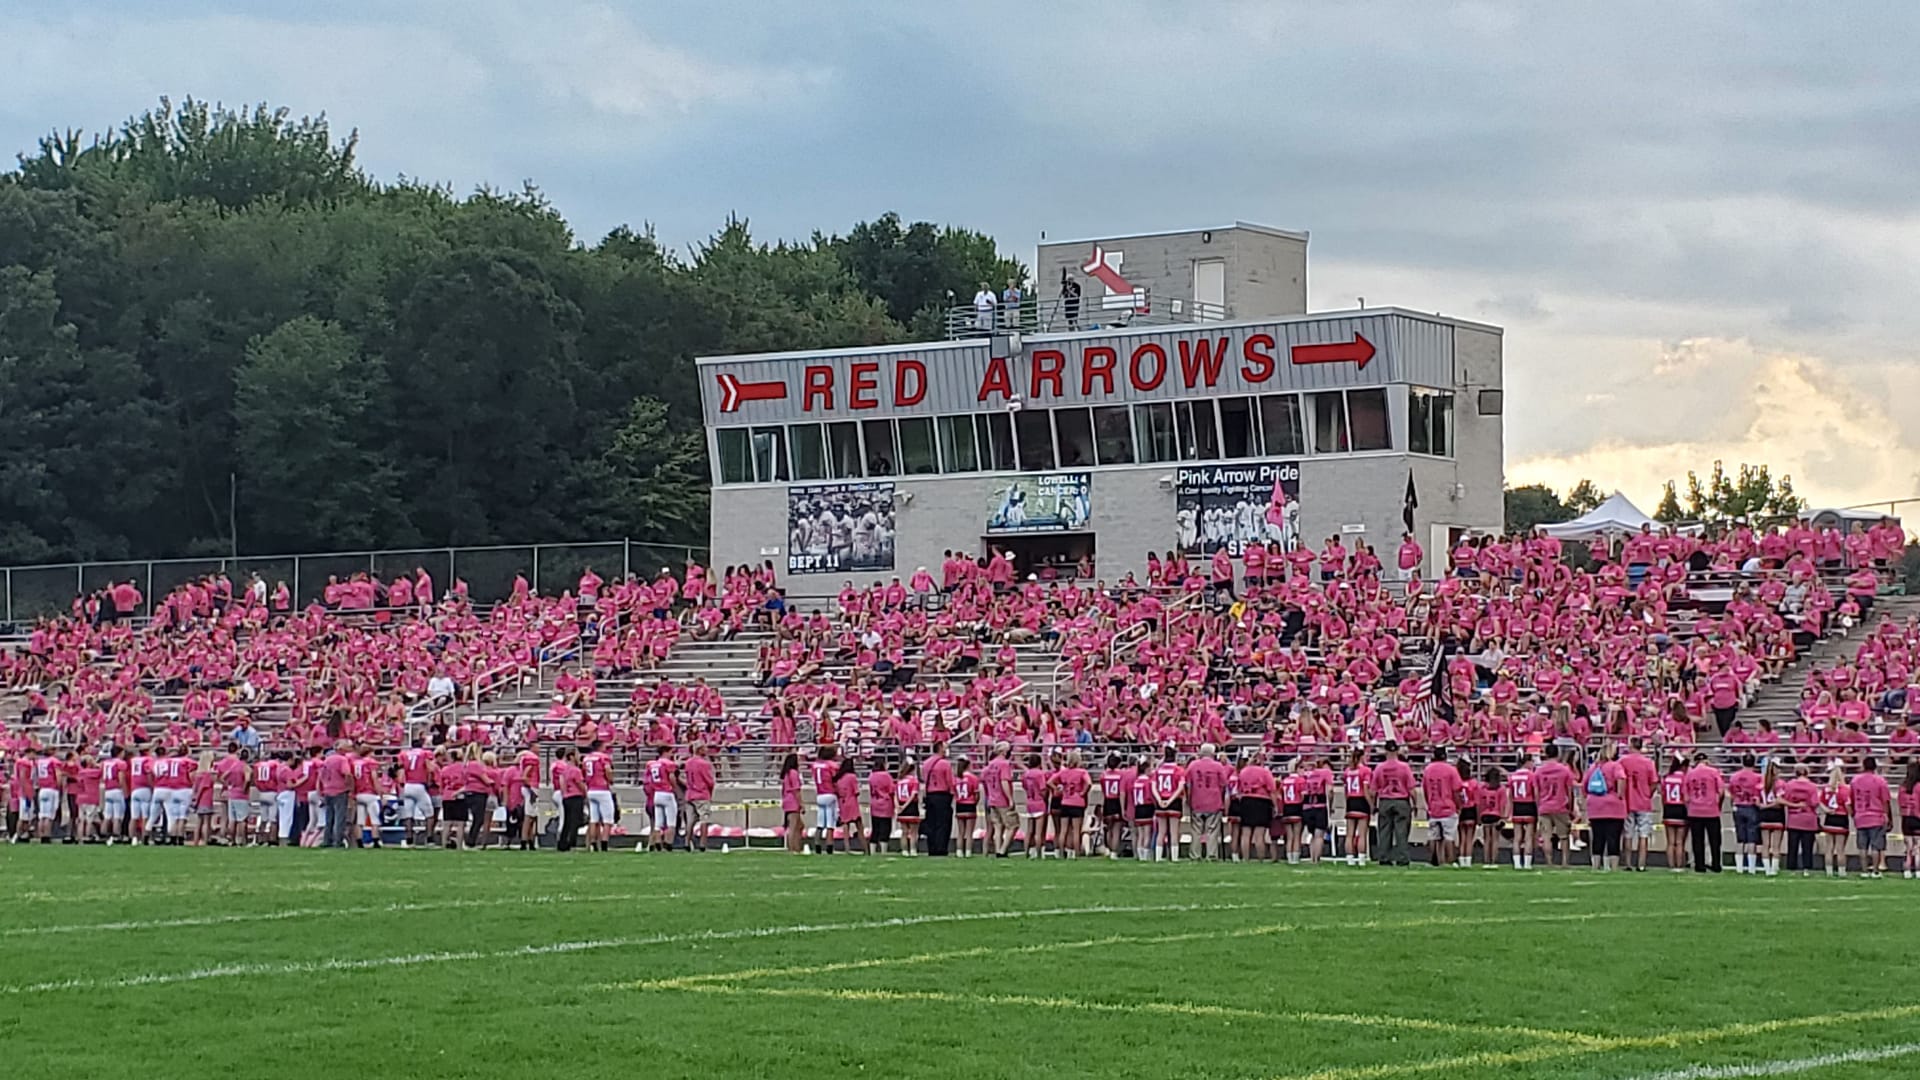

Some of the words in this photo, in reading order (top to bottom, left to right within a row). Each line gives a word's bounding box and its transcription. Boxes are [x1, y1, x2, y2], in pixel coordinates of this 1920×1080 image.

[803, 360, 928, 411] RED
[978, 334, 1275, 402] ARROWS
[1080, 474, 1087, 483] 4
[1179, 469, 1210, 485] Pink
[1213, 468, 1256, 483] Arrow
[1260, 465, 1299, 481] Pride
[1228, 539, 1272, 556] SET
[789, 555, 822, 569] SEPT
[826, 554, 839, 567] 11
[897, 784, 910, 798] 14
[956, 783, 968, 799] 14
[1105, 781, 1118, 797] 14
[1158, 775, 1171, 792] 14
[1345, 776, 1360, 793] 14
[1513, 781, 1526, 798] 14
[1283, 785, 1295, 801] 14
[1665, 784, 1680, 801] 14
